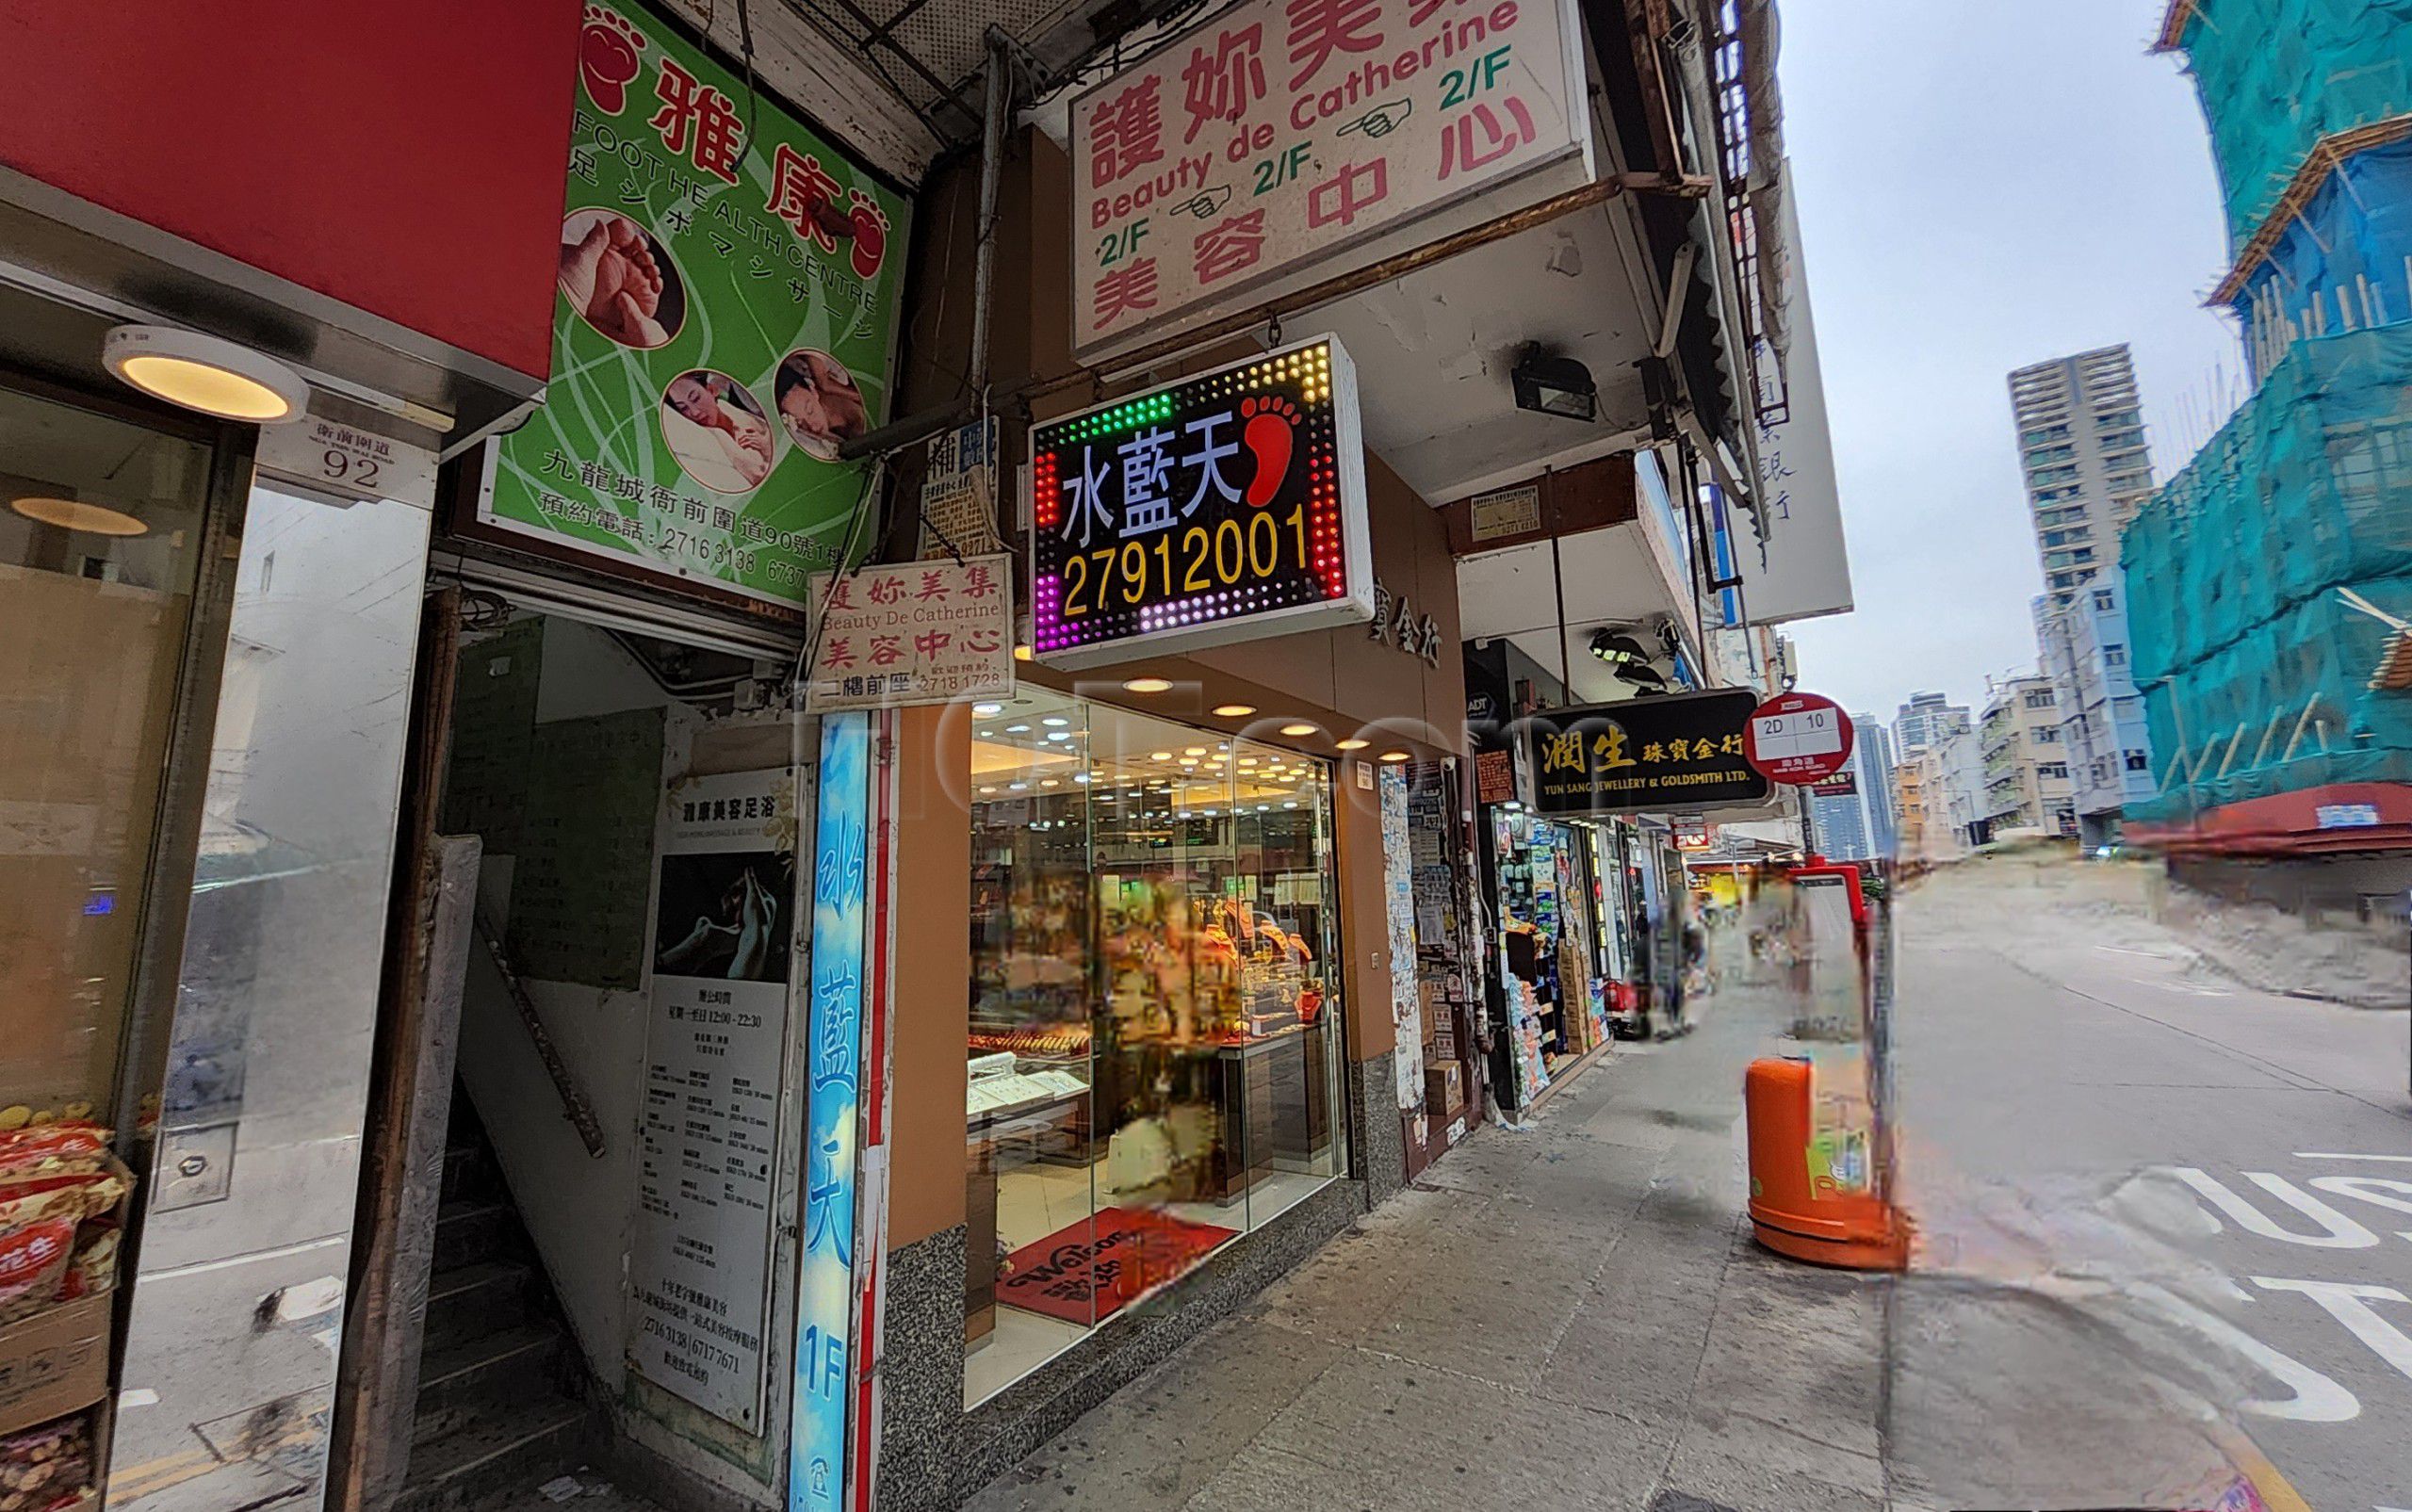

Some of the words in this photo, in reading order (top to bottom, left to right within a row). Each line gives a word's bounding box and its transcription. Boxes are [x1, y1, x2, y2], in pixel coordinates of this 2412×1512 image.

[1438, 44, 1512, 112] 2/F
[1091, 151, 1213, 230] Beauty
[1227, 119, 1275, 164] de
[1290, 2, 1519, 132] Catherine
[646, 57, 844, 255] 雅康
[1252, 140, 1313, 197] 2/F
[573, 109, 663, 181] FOOT
[787, 244, 877, 313] CENTRE
[1092, 95, 1537, 331] 美容中心
[1099, 217, 1150, 268] 2/F
[323, 449, 380, 489] 92
[1061, 410, 1243, 549] 水藍天
[663, 528, 710, 561] 2716
[713, 543, 756, 574] 3138
[1064, 503, 1307, 617] 27912001
[823, 610, 881, 631] Beauty
[887, 610, 909, 626] De
[914, 602, 999, 623] Catherine
[820, 628, 1001, 670] 美容中心
[963, 674, 1001, 690] 1728
[1468, 697, 1488, 711] ADT
[1764, 719, 1784, 735] 2D
[1806, 713, 1825, 729] 10
[1544, 785, 1564, 795] YUN
[1567, 781, 1592, 793] SANG
[1594, 777, 1647, 792] JEWELLERY
[1649, 779, 1658, 788] &
[1661, 772, 1722, 788] GOLDSMITH
[1725, 771, 1751, 782] LTD.
[807, 809, 864, 1272] 水藍天
[805, 1324, 843, 1402] 1F
